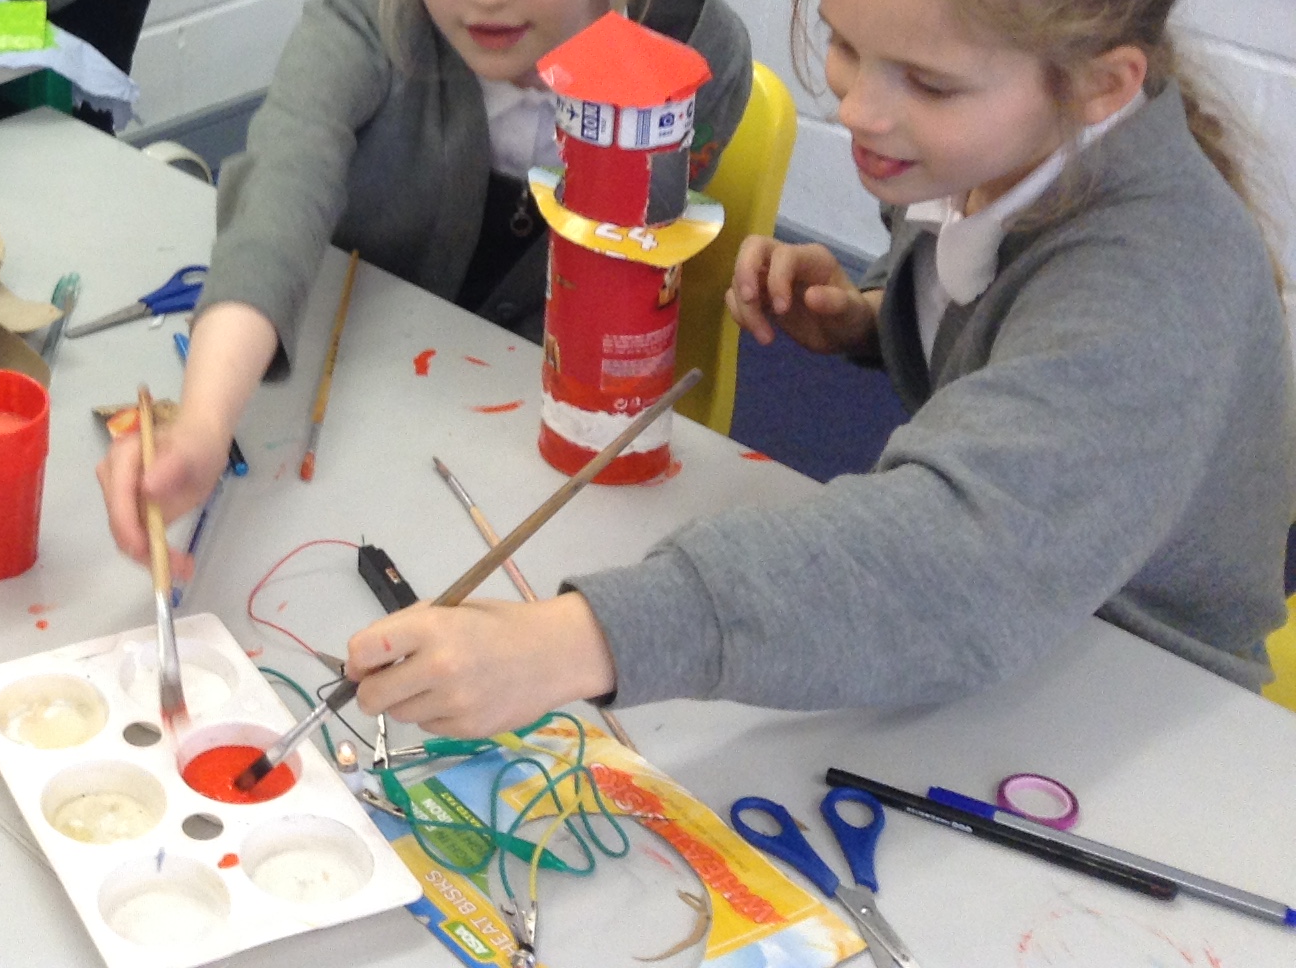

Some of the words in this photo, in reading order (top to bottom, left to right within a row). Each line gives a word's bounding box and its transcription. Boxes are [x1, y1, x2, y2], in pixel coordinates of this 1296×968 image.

[424, 869, 478, 916] BISKS
[454, 923, 490, 955] ASDA
[471, 916, 518, 958] HEAT
